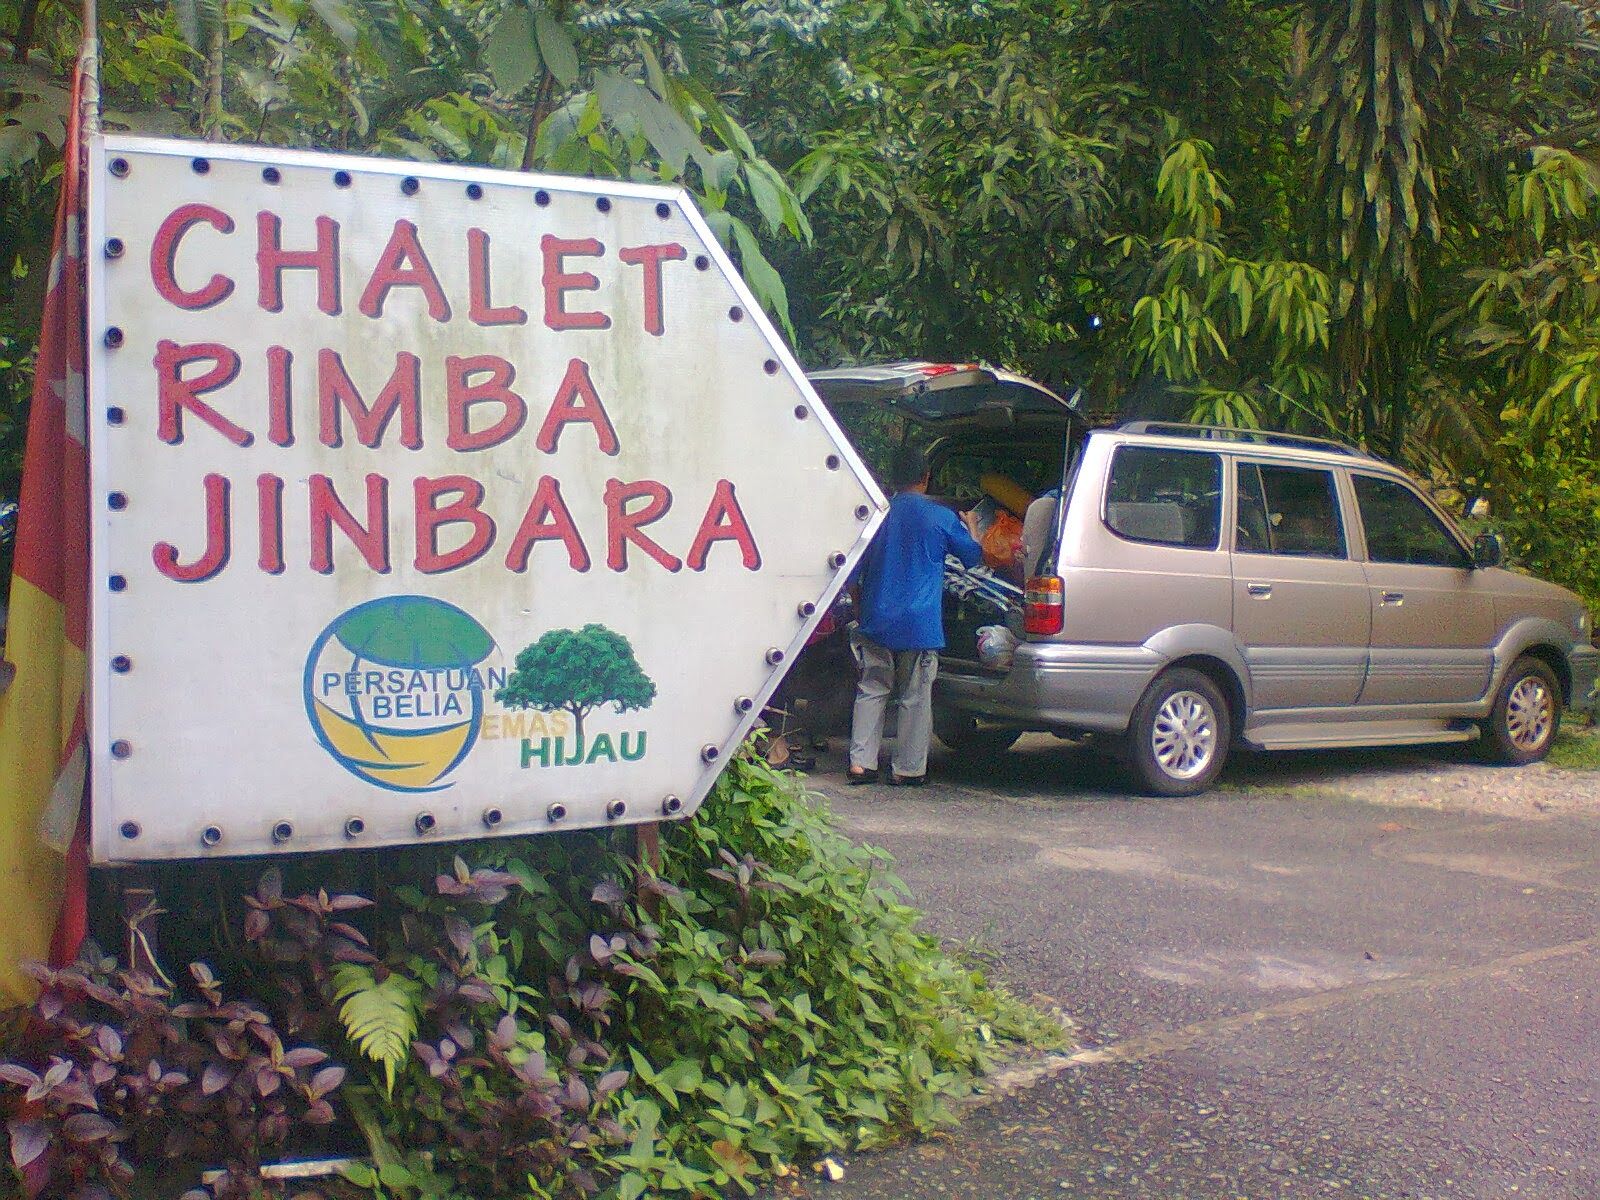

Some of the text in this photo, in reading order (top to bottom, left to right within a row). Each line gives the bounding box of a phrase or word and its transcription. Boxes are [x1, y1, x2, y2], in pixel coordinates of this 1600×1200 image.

[150, 203, 687, 336] CHALET
[152, 338, 621, 455] RIMBA
[152, 472, 762, 583] JINBARA
[322, 666, 507, 697] PERSATUAN
[372, 691, 463, 719] BELIA
[480, 711, 570, 741] EMAS
[520, 730, 648, 769] HIJAU
